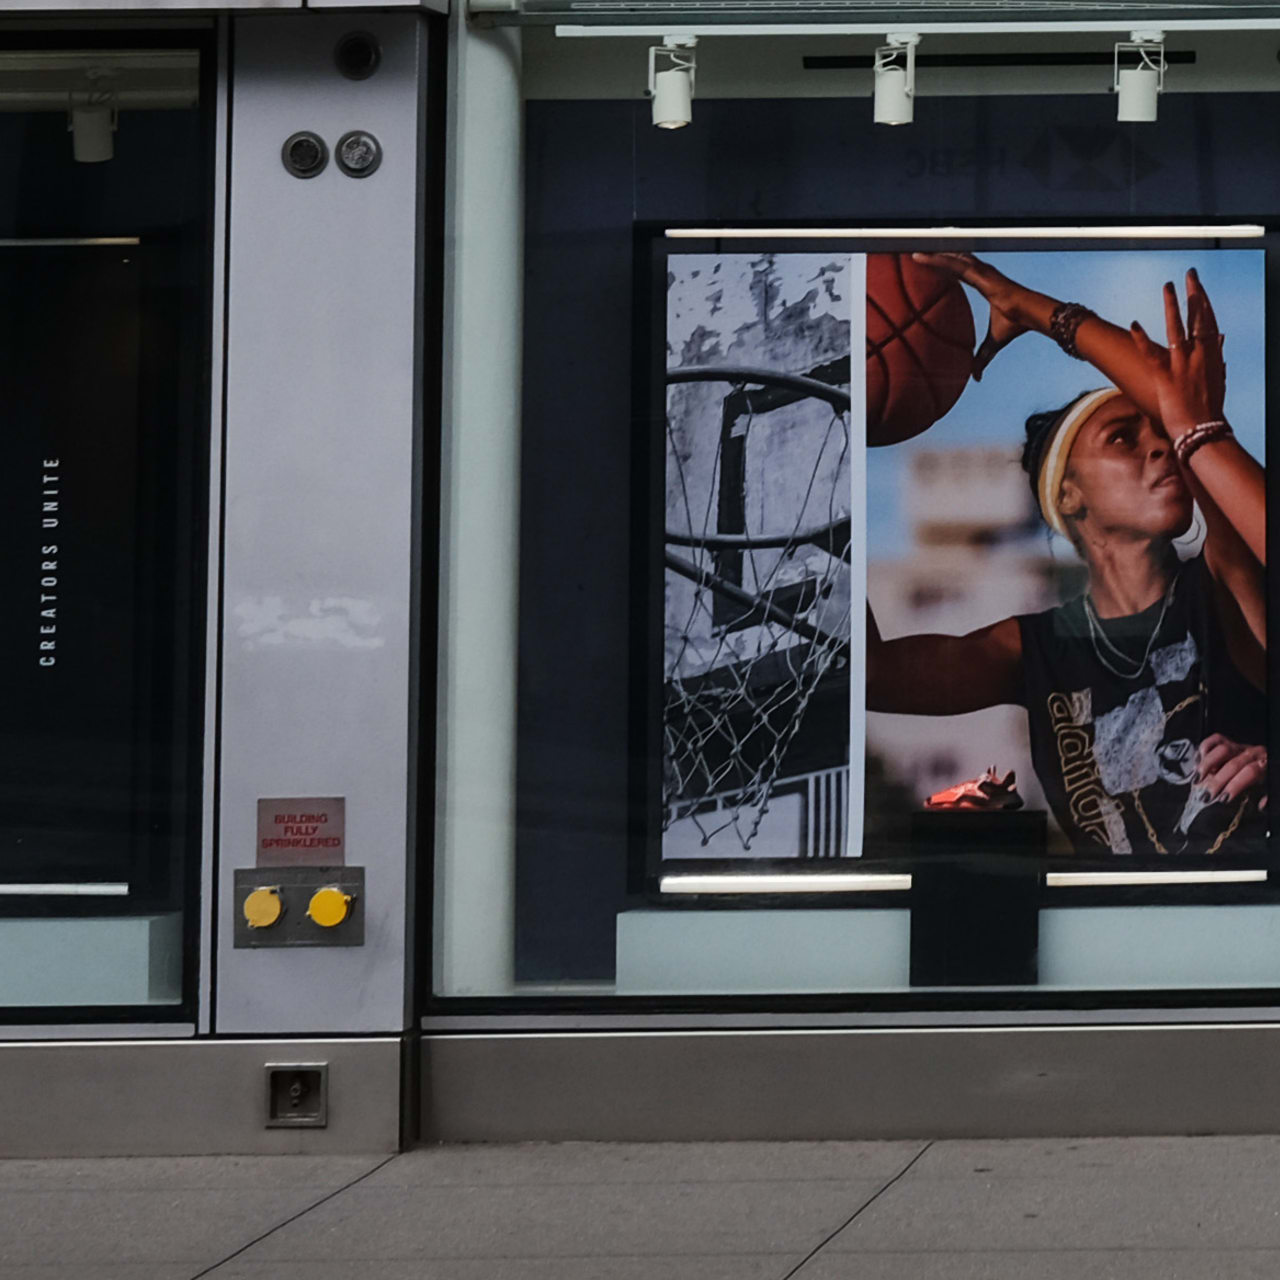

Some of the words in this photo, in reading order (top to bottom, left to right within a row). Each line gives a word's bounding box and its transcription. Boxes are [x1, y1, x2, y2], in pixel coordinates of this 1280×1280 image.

[42, 458, 59, 528] UNITE
[39, 544, 58, 666] CREATORS
[274, 813, 328, 824] BUILDING
[283, 825, 318, 836] FULLY
[262, 837, 341, 849] SPRINKLERED
